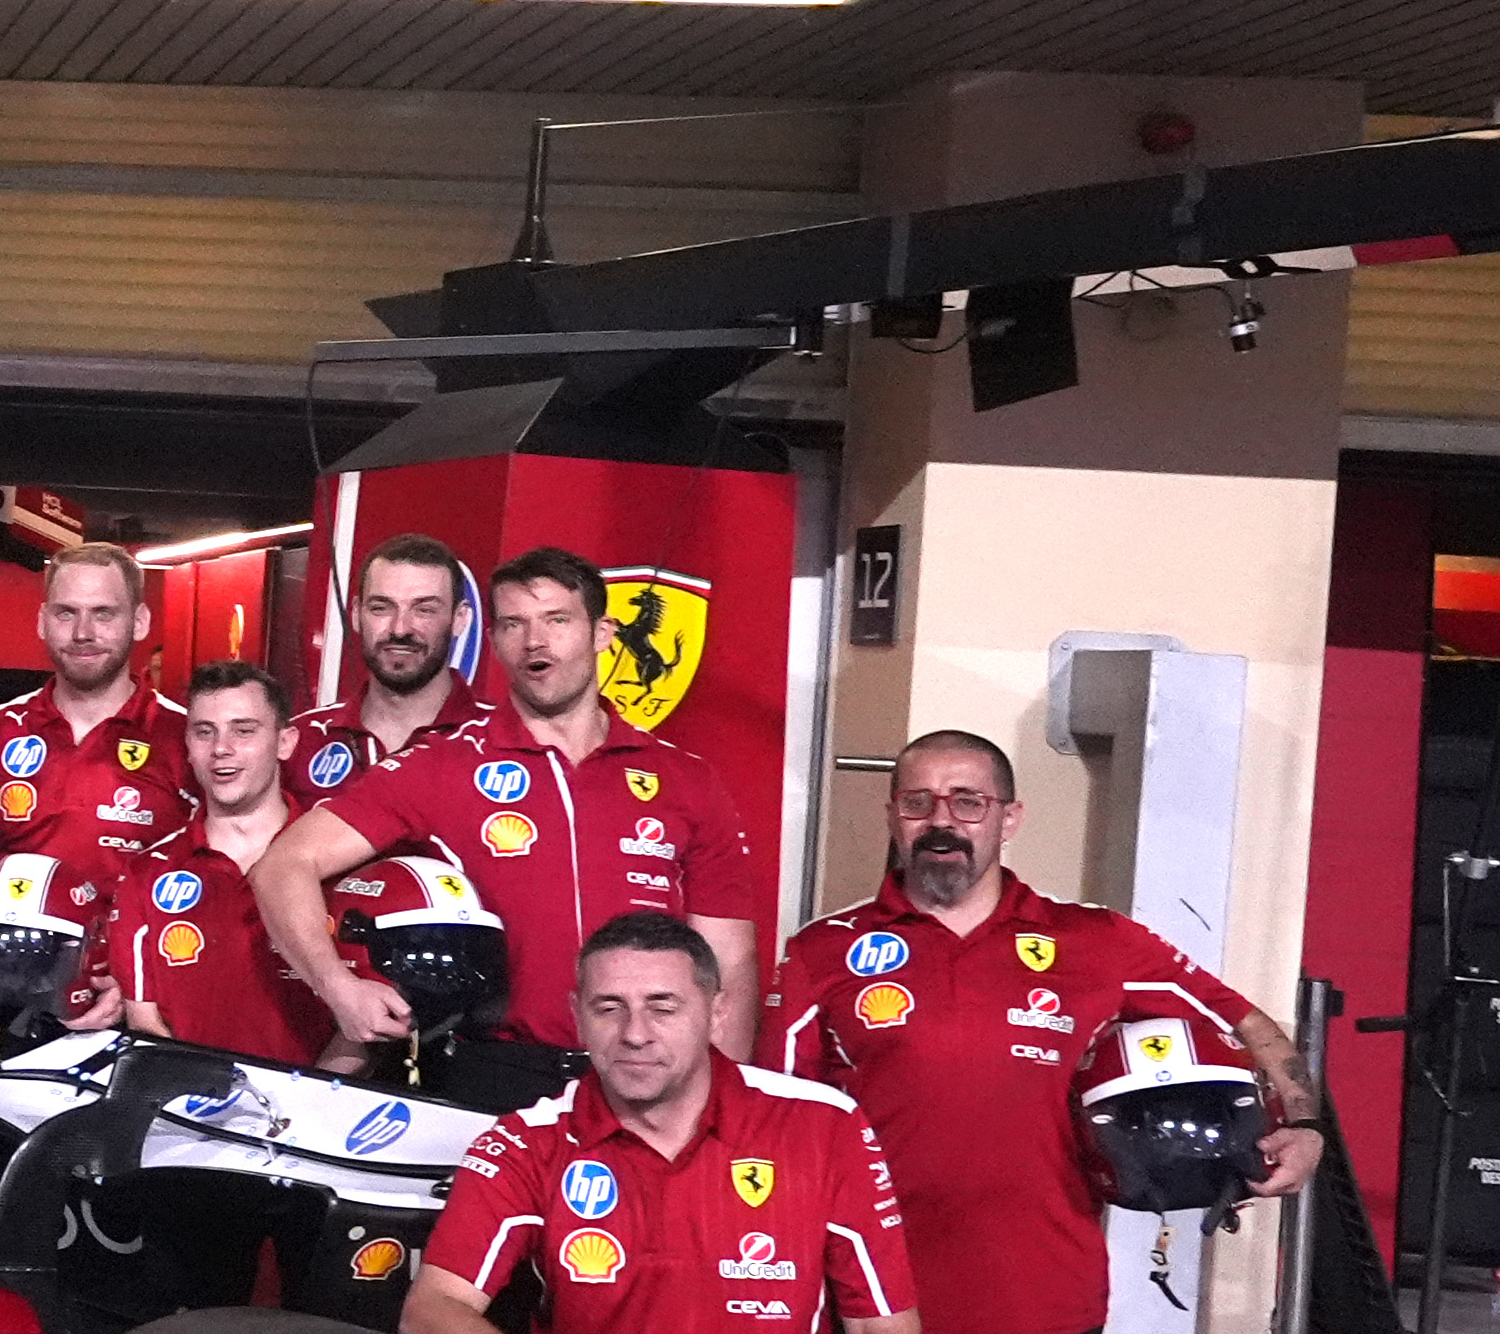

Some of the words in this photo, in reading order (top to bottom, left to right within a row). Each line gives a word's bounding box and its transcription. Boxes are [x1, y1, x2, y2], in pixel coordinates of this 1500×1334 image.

[859, 552, 893, 609] 12
[4, 735, 45, 777] hp
[311, 742, 351, 787] hp
[479, 760, 527, 803] hp
[97, 806, 154, 826] UniCredit
[99, 835, 144, 850] CEVA
[620, 838, 676, 860] UniCredit
[155, 870, 197, 913] hp
[627, 871, 671, 888] CEVA
[851, 931, 905, 977] hp
[1007, 1008, 1075, 1034] UniCredit
[1011, 1044, 1060, 1062] CEVA
[352, 1100, 404, 1155] hp
[566, 1160, 615, 1220] hp
[719, 1260, 796, 1282] UniCredit
[727, 1298, 791, 1316] CEVA
